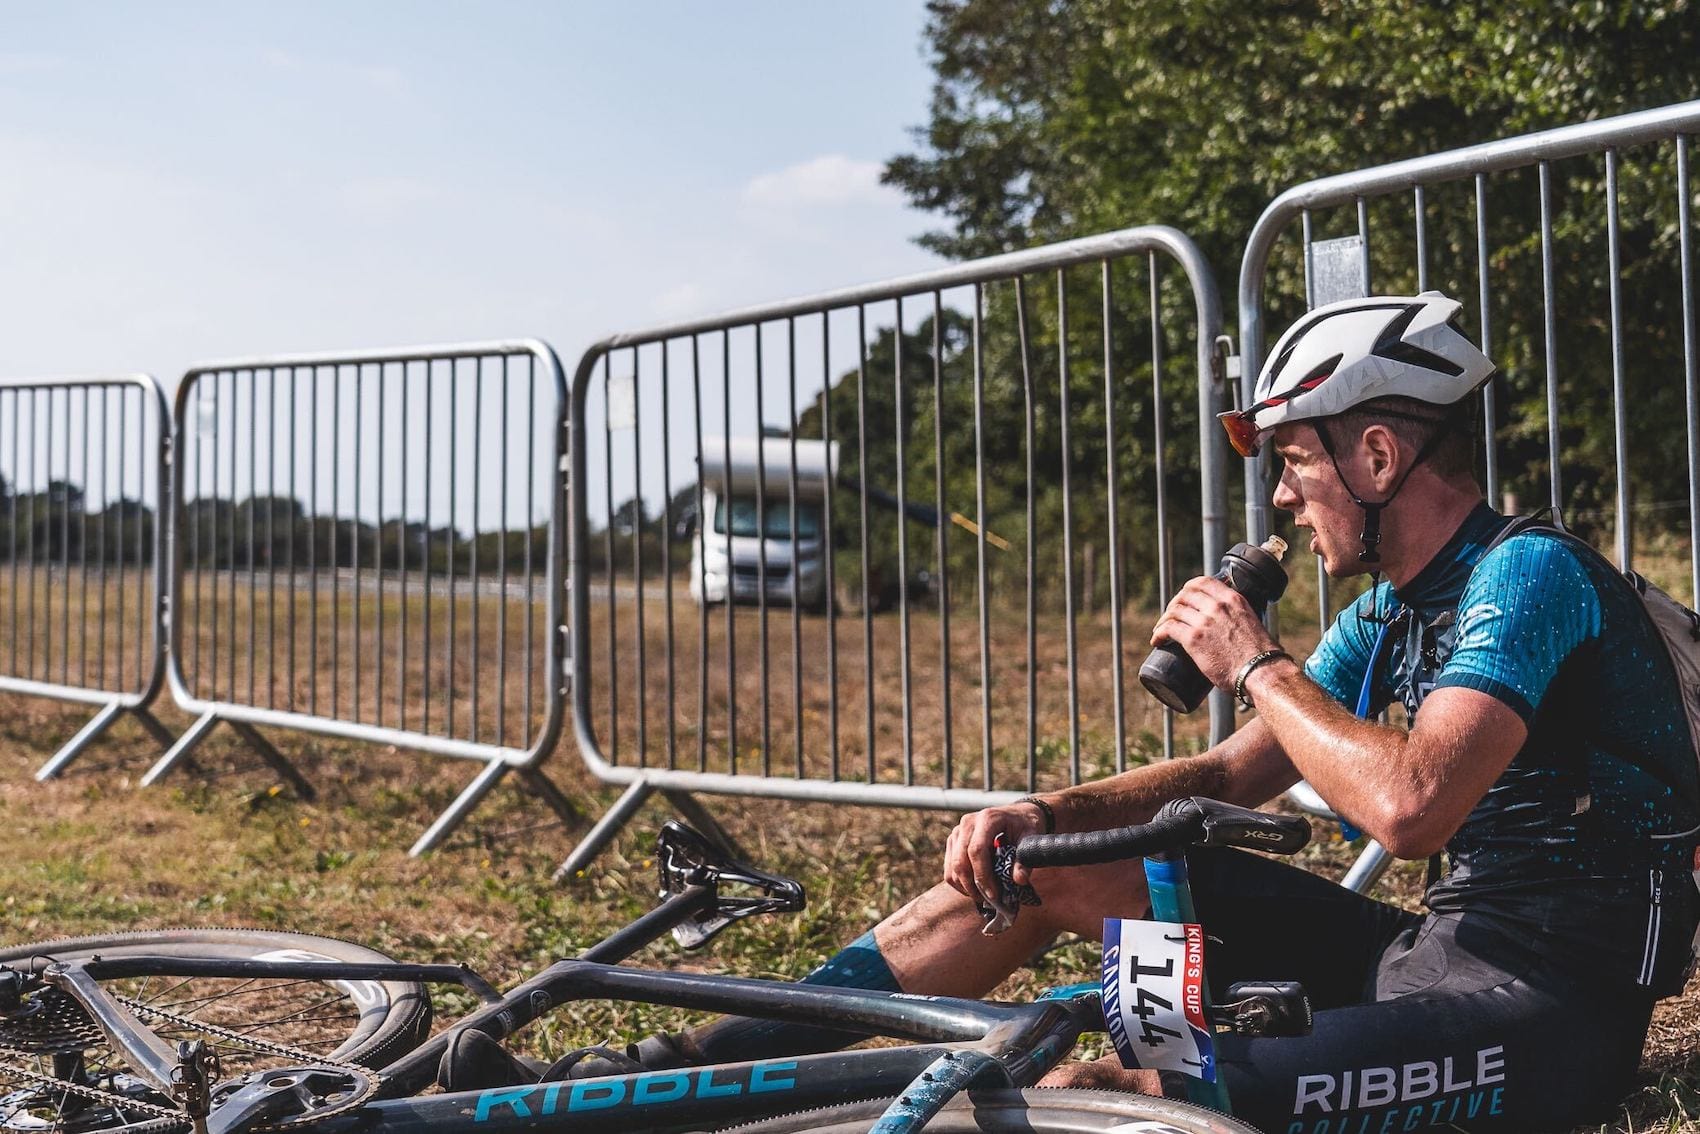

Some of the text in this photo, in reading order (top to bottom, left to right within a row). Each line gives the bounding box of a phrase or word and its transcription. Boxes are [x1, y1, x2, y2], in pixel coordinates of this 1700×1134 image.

[1245, 830, 1284, 841] GRX
[1103, 944, 1128, 1049] CANYON
[1131, 955, 1183, 1047] 144
[1186, 928, 1201, 1014] KING'S CUP
[474, 1061, 798, 1122] RIBBLE
[1294, 1045, 1505, 1114] RIBBLE
